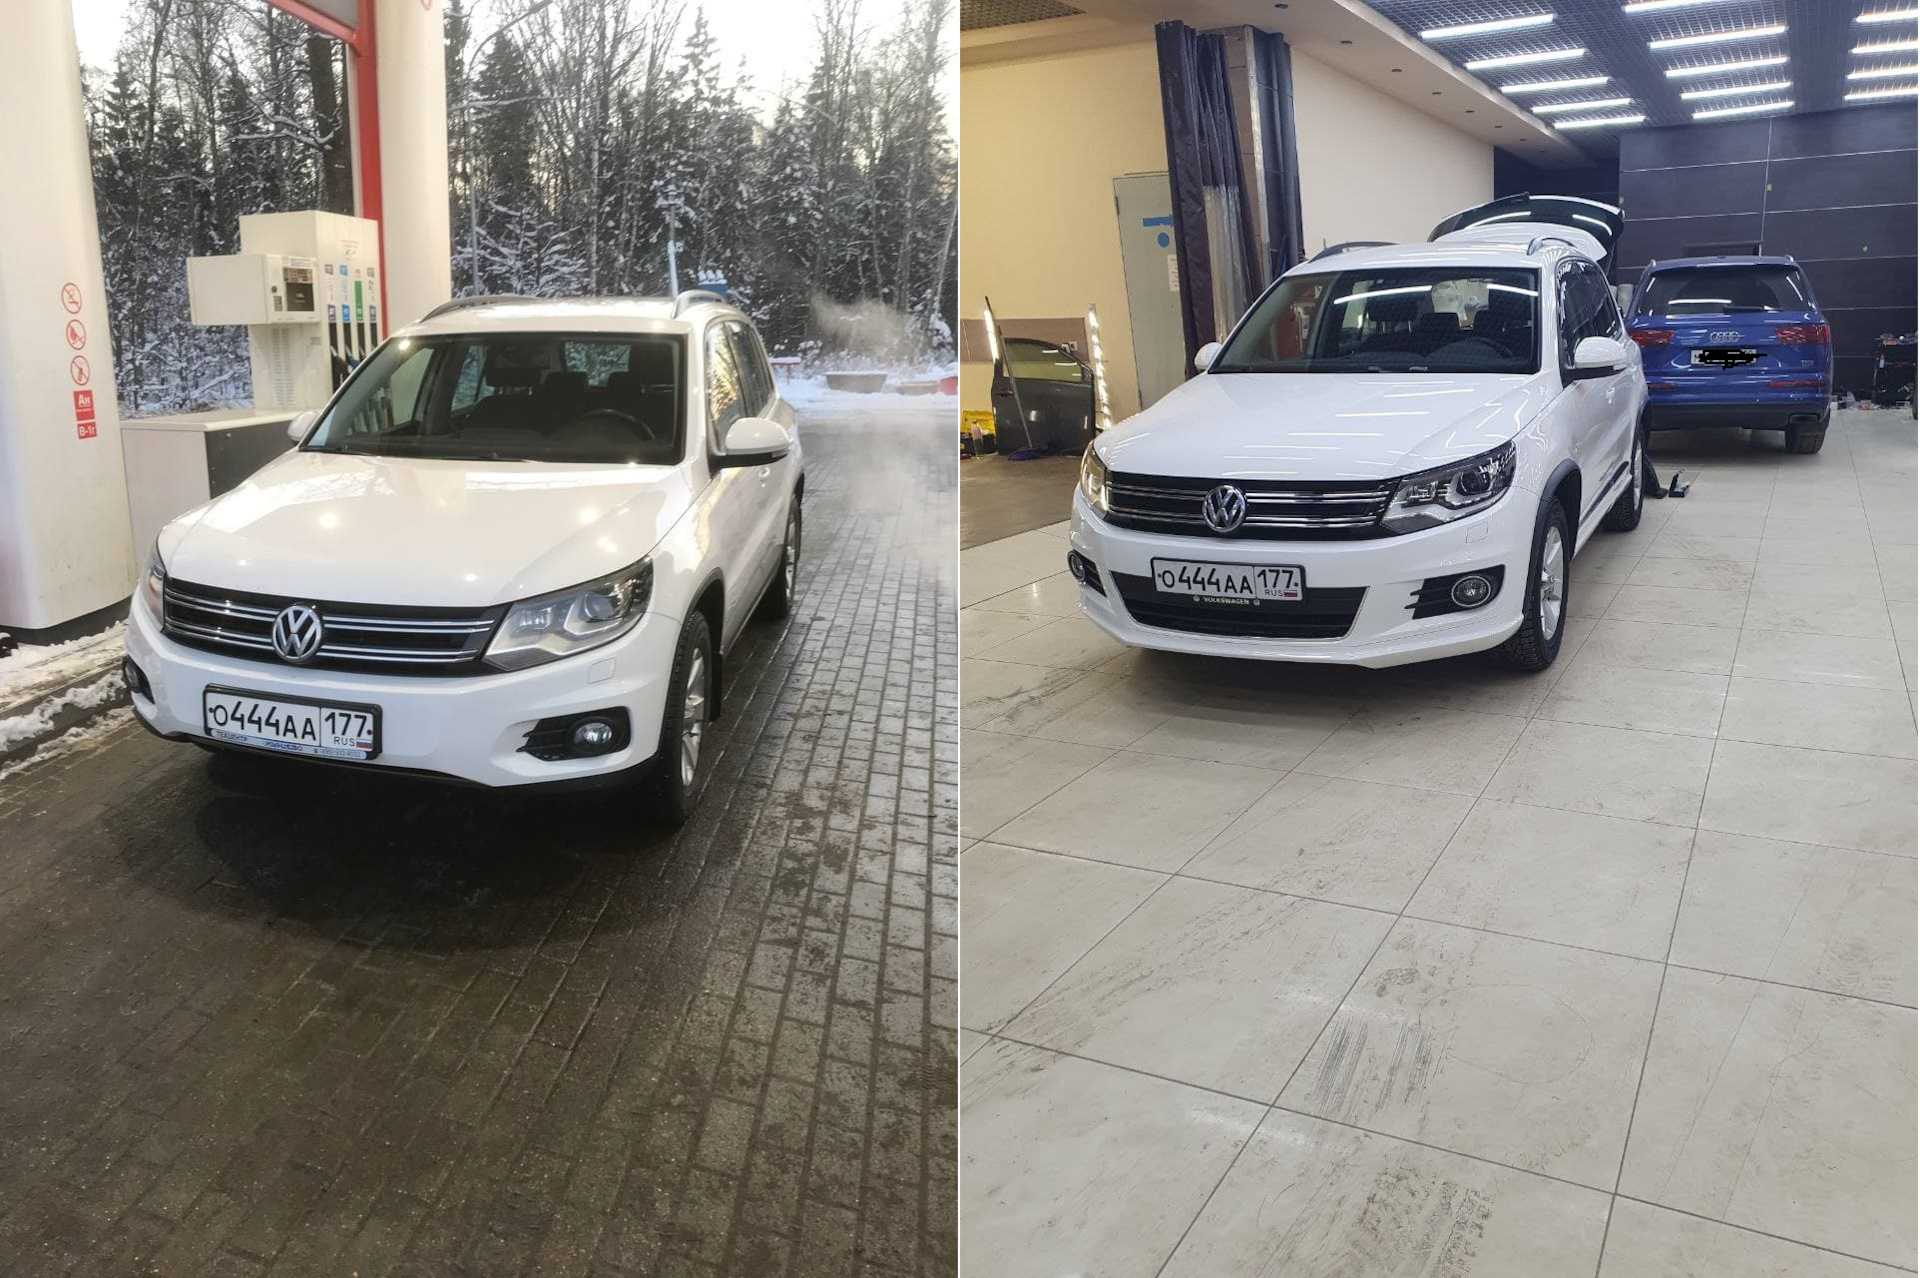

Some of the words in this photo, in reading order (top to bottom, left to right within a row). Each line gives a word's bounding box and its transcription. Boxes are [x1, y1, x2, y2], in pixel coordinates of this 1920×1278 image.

[1257, 569, 1294, 589] 177
[1264, 589, 1283, 597] RUS
[1203, 596, 1250, 605] VOLKSWAGEN
[324, 712, 368, 738] 177
[333, 736, 356, 747] RUS
